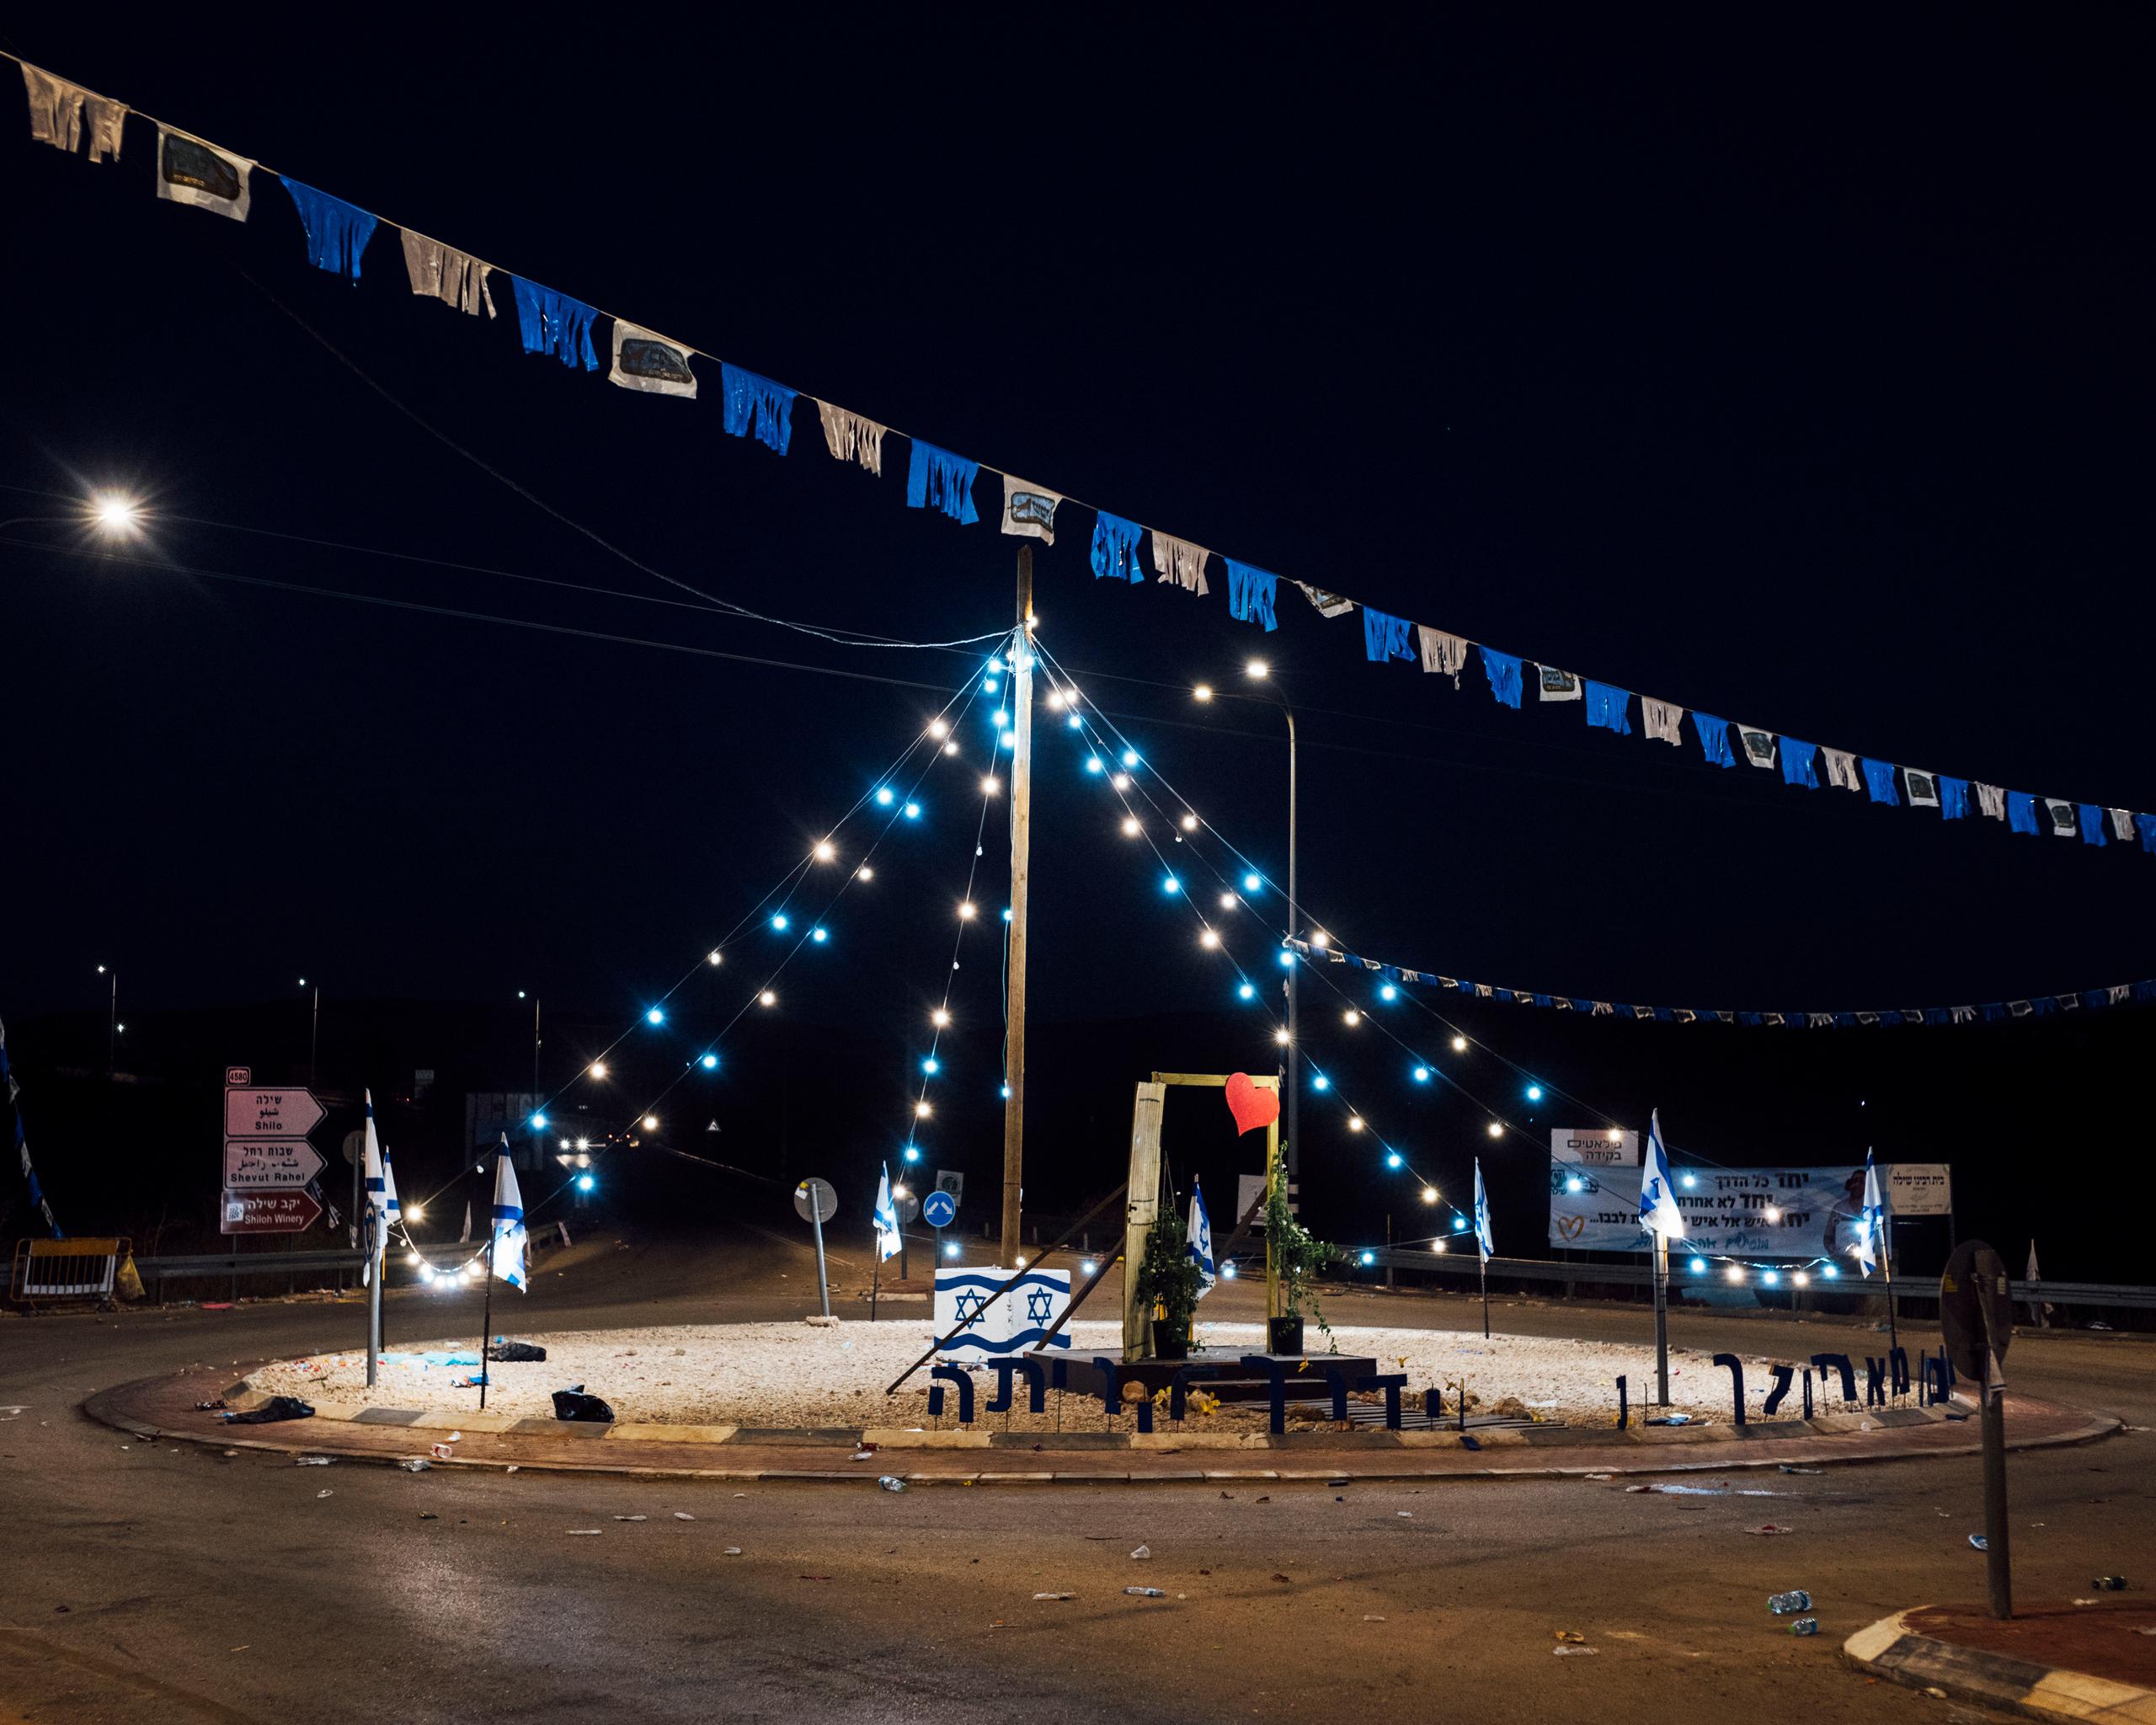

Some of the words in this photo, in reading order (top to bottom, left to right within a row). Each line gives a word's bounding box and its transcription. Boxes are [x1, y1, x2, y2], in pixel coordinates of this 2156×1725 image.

[229, 1071, 248, 1081] 4580
[256, 1095, 282, 1104] שילה
[255, 1121, 282, 1130] Shilo
[243, 1146, 262, 1156] רחל
[268, 1146, 293, 1156] שבות
[1586, 1151, 1622, 1162] בקידה
[231, 1172, 270, 1183] Shevut
[275, 1172, 305, 1182] Rahel
[1715, 1175, 1748, 1190] הדרך
[1752, 1174, 1769, 1188] כל
[1774, 1172, 1809, 1188] יחד
[1892, 1172, 1913, 1185] שילה
[248, 1198, 277, 1210] שילה
[281, 1199, 301, 1210] יקב
[1676, 1195, 1714, 1208] אחרת
[1717, 1195, 1736, 1209] לא
[1739, 1193, 1774, 1209] יחד
[245, 1213, 272, 1225] Shiloh
[275, 1214, 304, 1226] Winery
[1691, 1215, 1719, 1227] איש
[1721, 1214, 1740, 1227] אל
